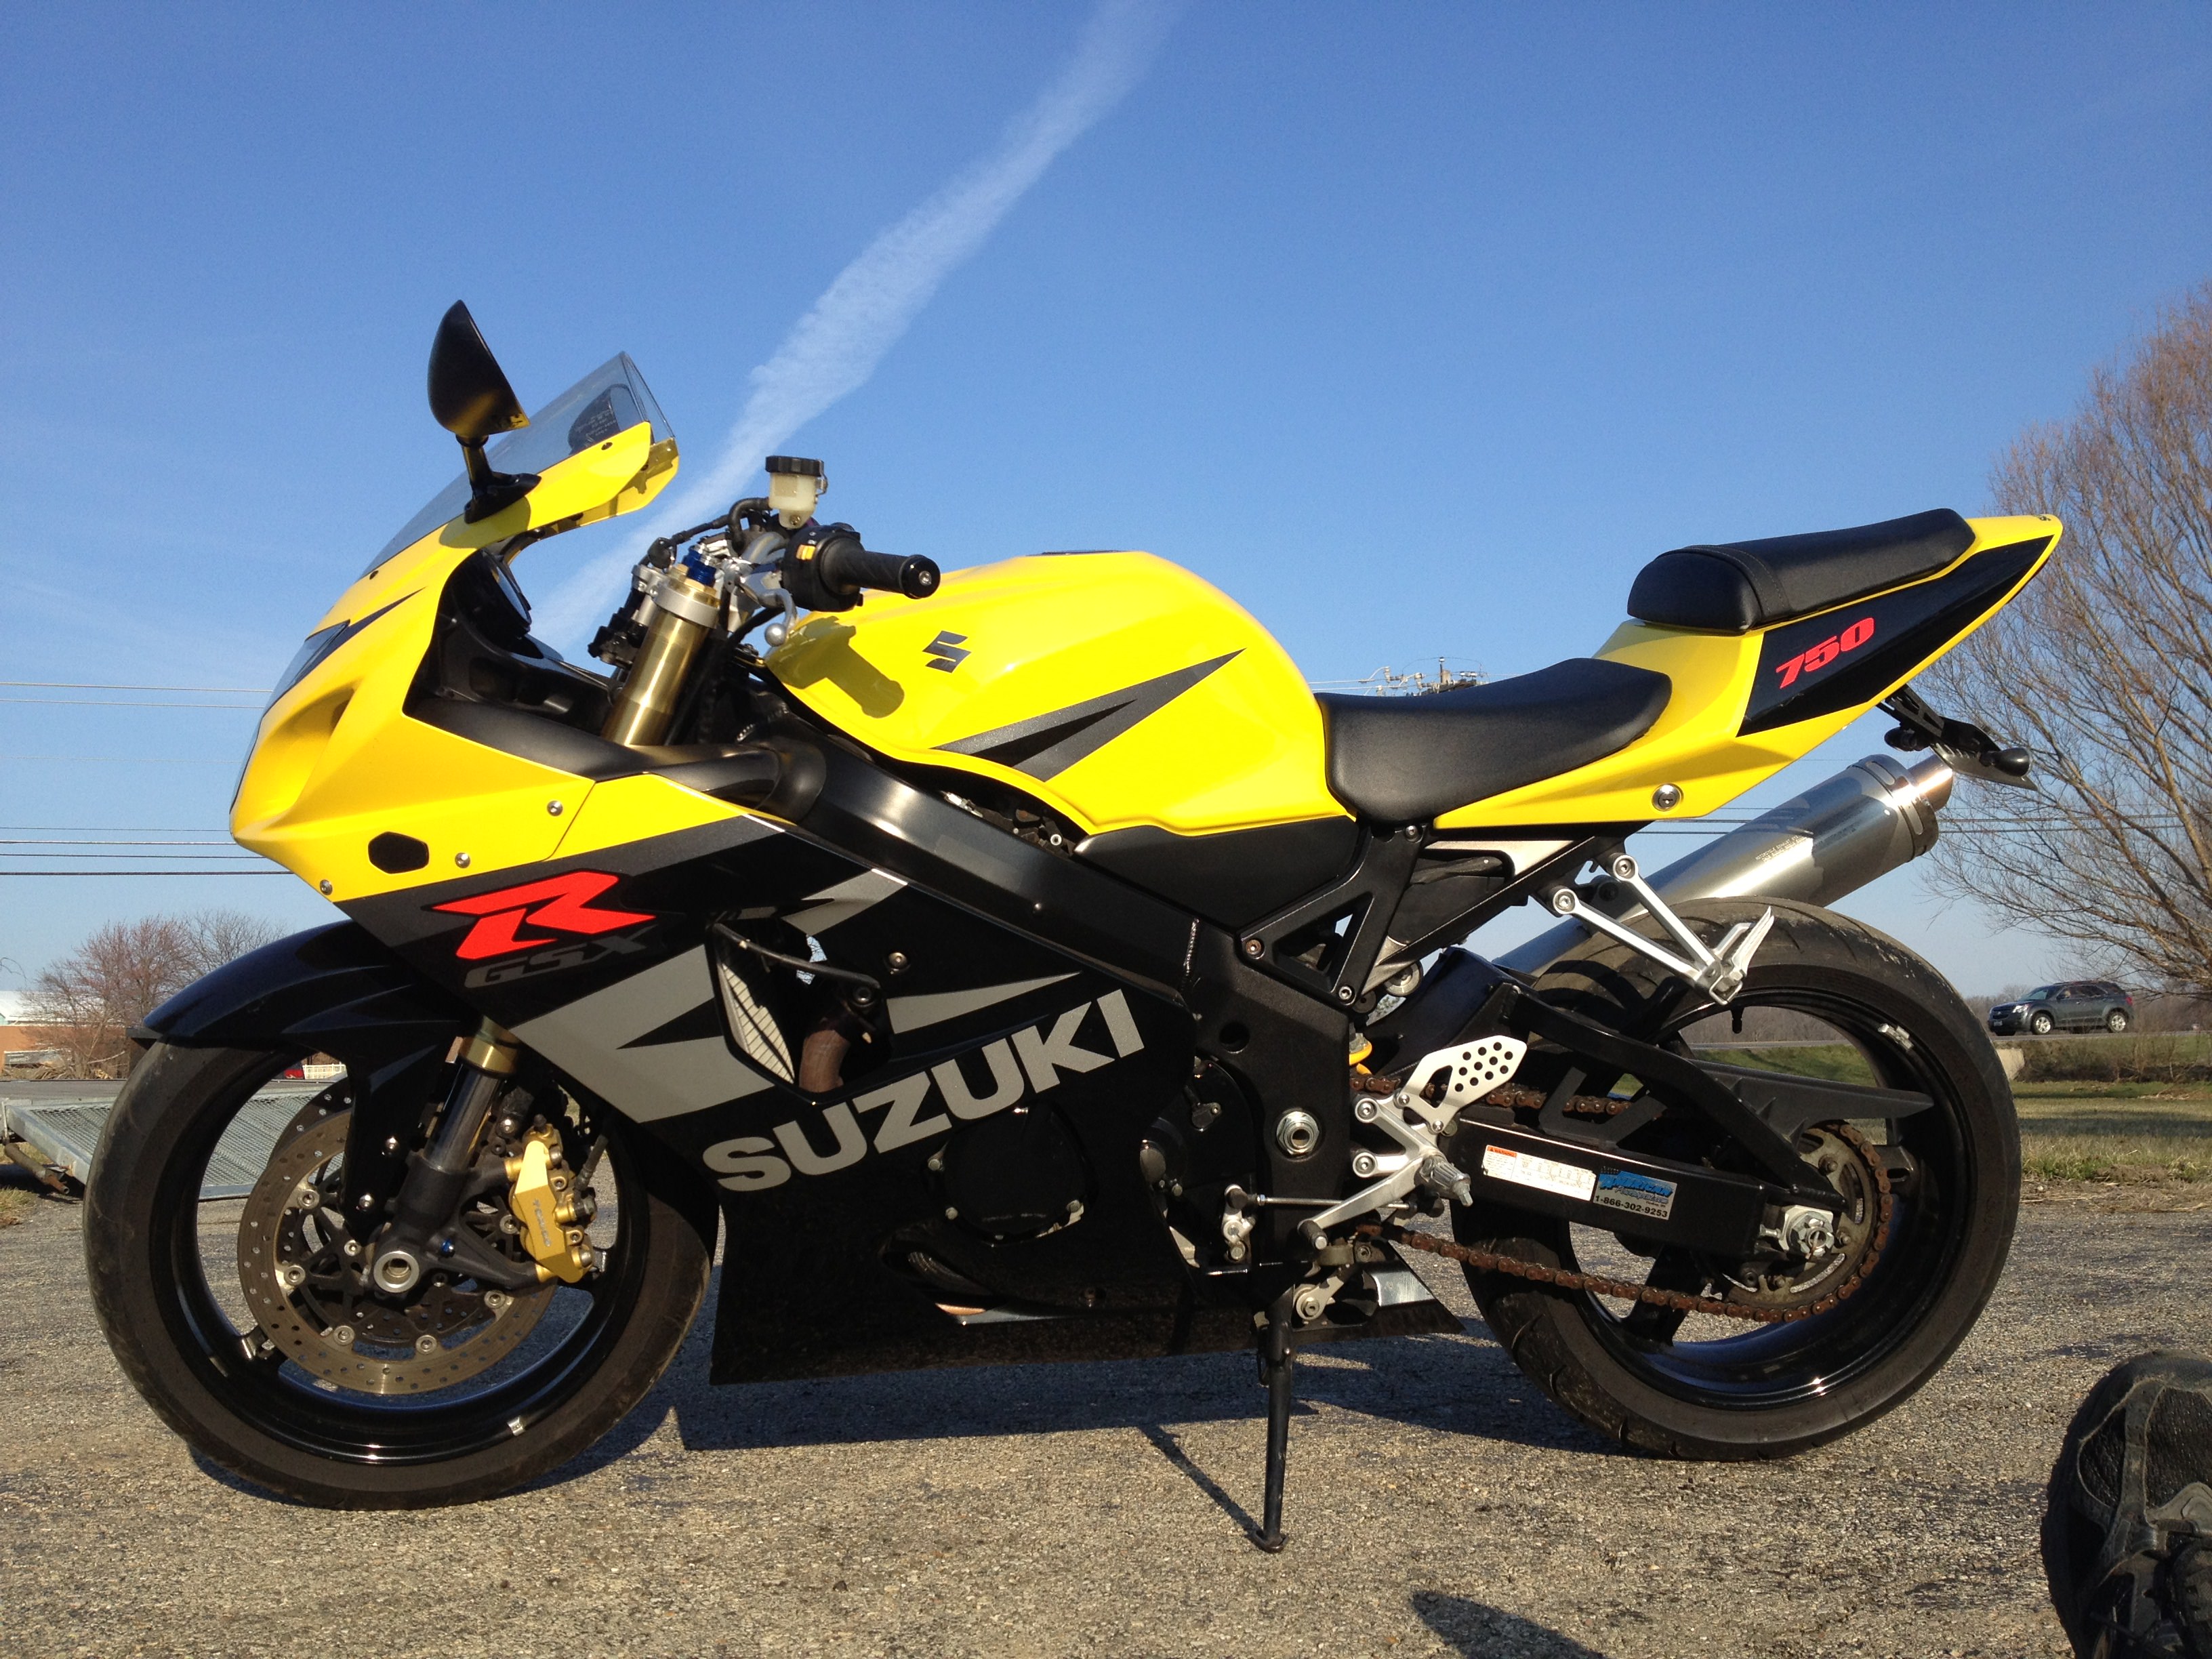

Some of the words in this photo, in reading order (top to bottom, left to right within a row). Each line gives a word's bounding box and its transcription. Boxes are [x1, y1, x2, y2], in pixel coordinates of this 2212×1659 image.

[1776, 617, 1875, 689] 750
[432, 872, 657, 960] R
[464, 925, 659, 989] GSX
[702, 989, 1144, 1191] SUZUKI
[1595, 1195, 1668, 1218] 1-866-302-9253
